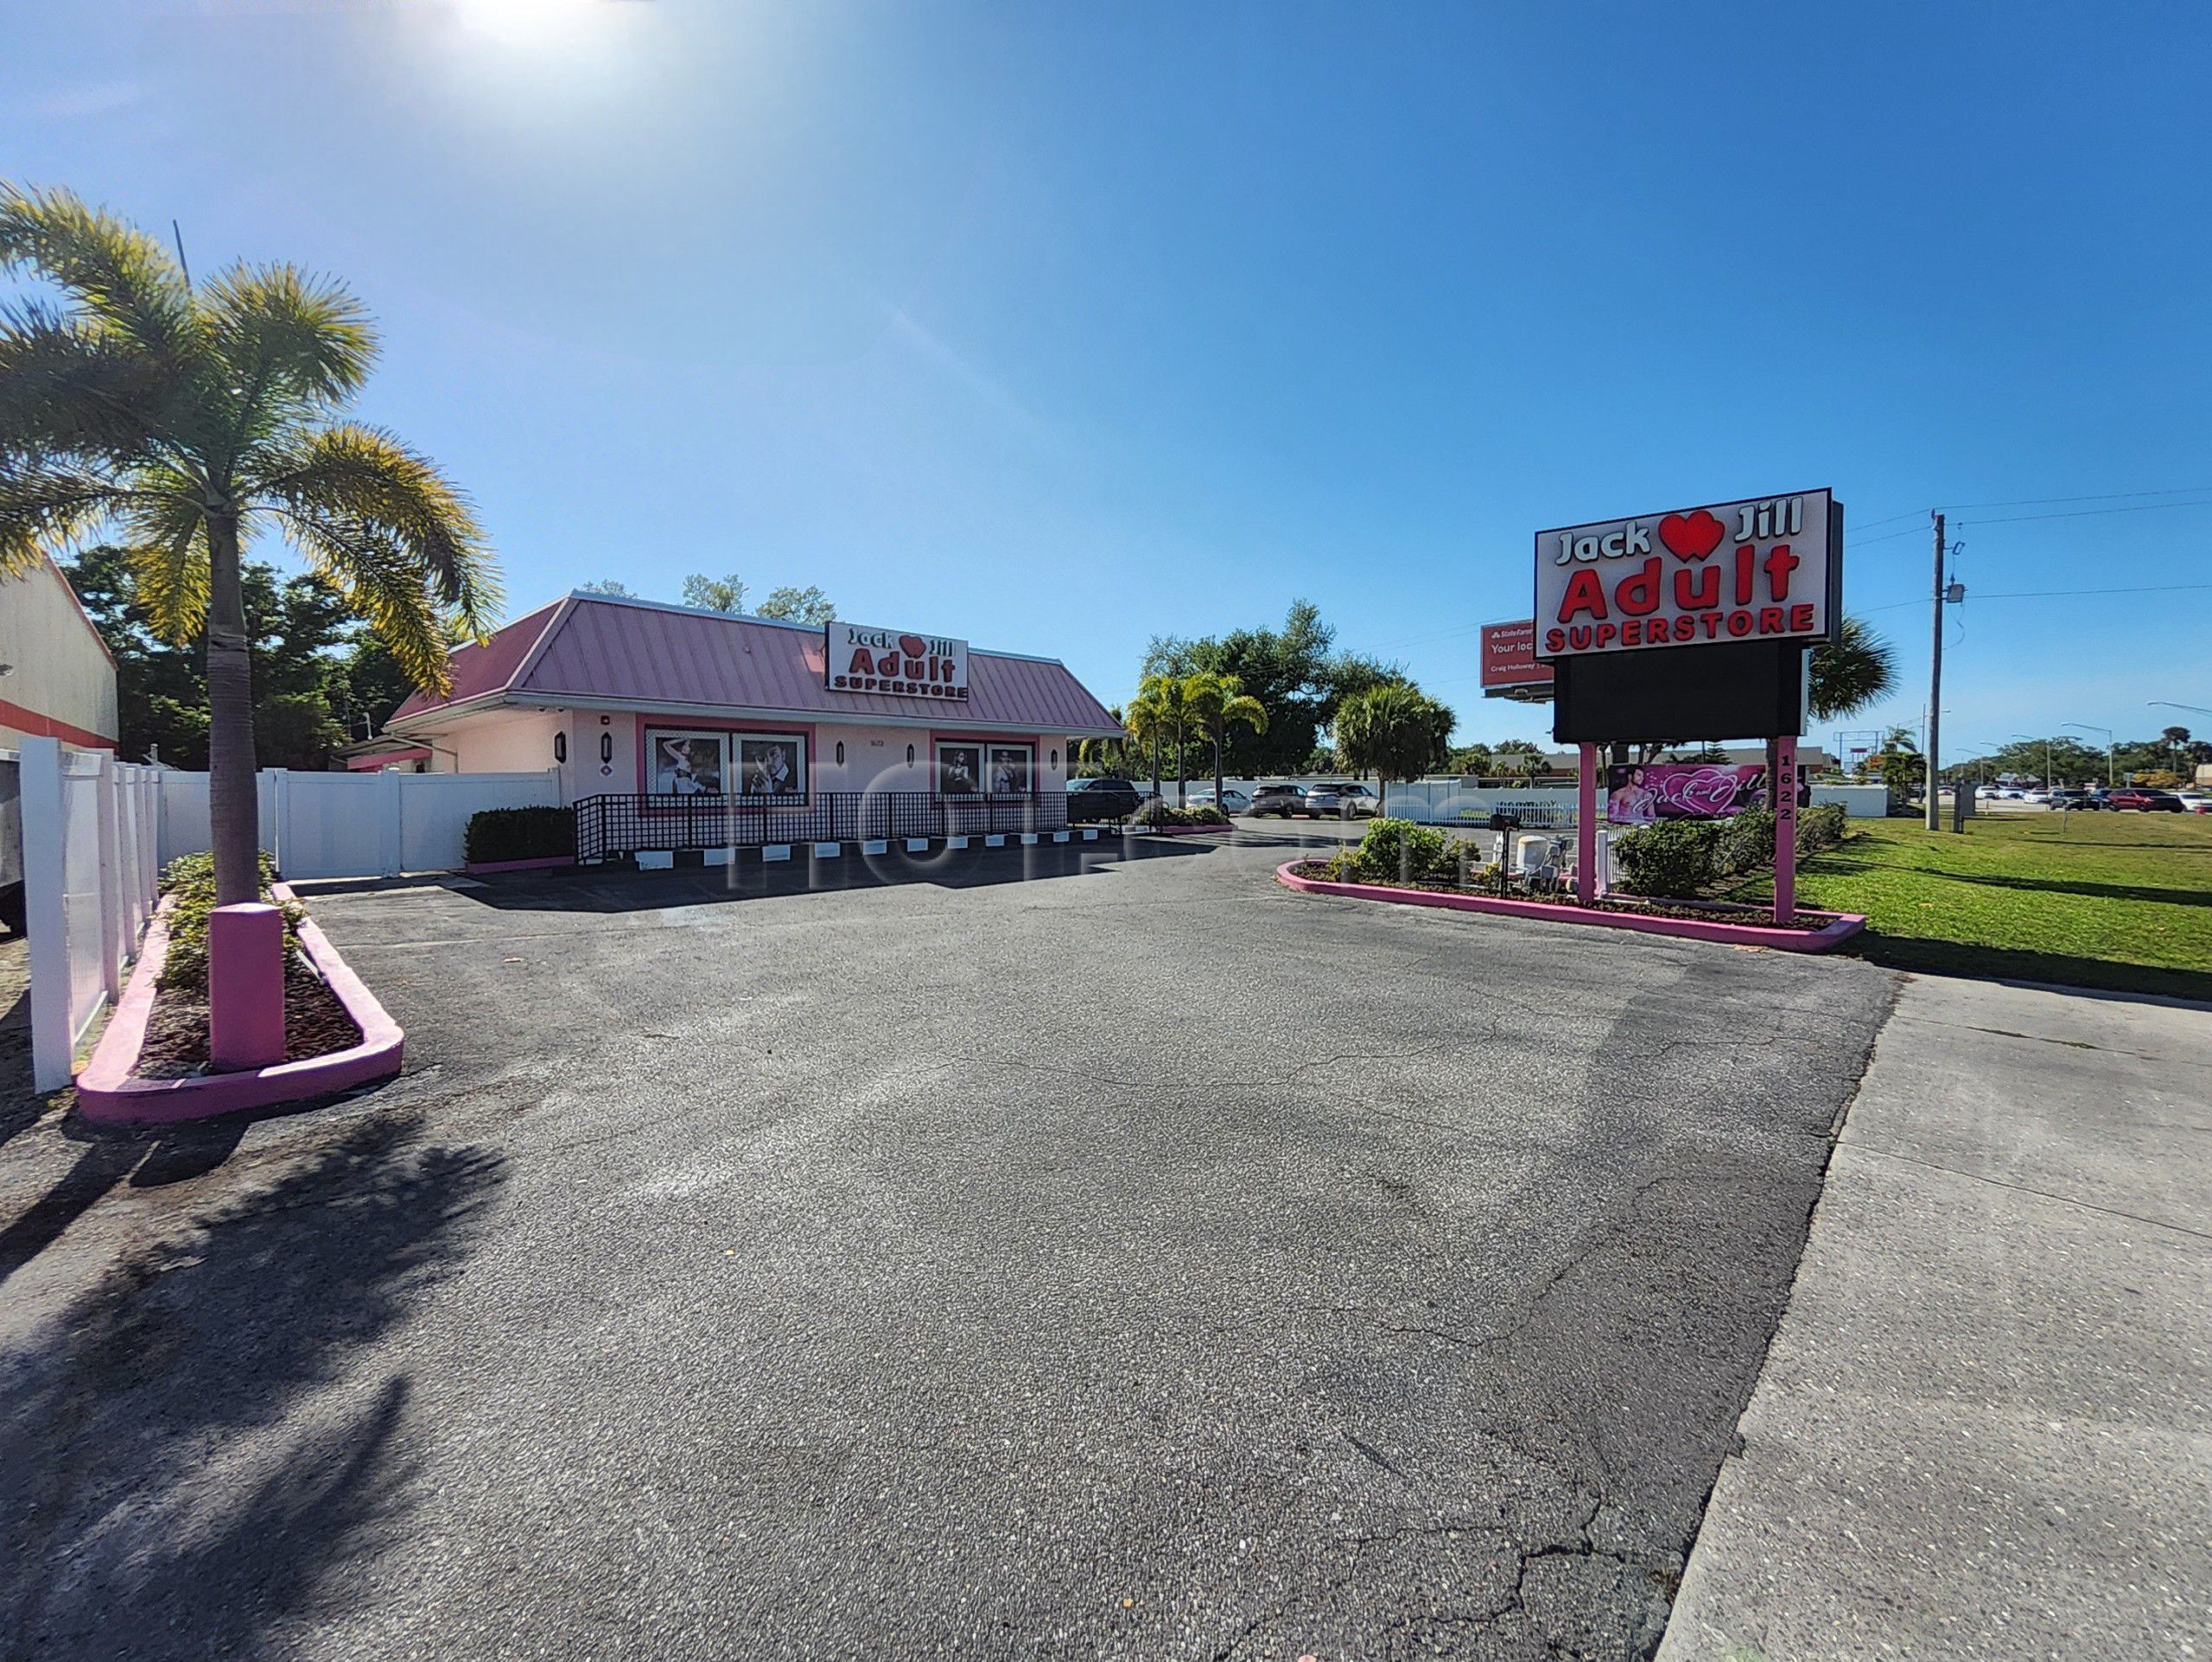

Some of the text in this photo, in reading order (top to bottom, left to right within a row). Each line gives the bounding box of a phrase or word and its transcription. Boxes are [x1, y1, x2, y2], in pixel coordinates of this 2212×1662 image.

[1555, 496, 1803, 566] Jack Jill
[1557, 544, 1800, 624] Adult
[848, 627, 956, 658] Jack Jill
[1545, 603, 1815, 653] SUPERSTORE
[849, 648, 956, 683] Adult
[1491, 643, 1516, 654] Your
[835, 675, 968, 698] SUPERSTORE
[1633, 781, 1694, 814] Jack
[1710, 772, 1766, 804] Jill
